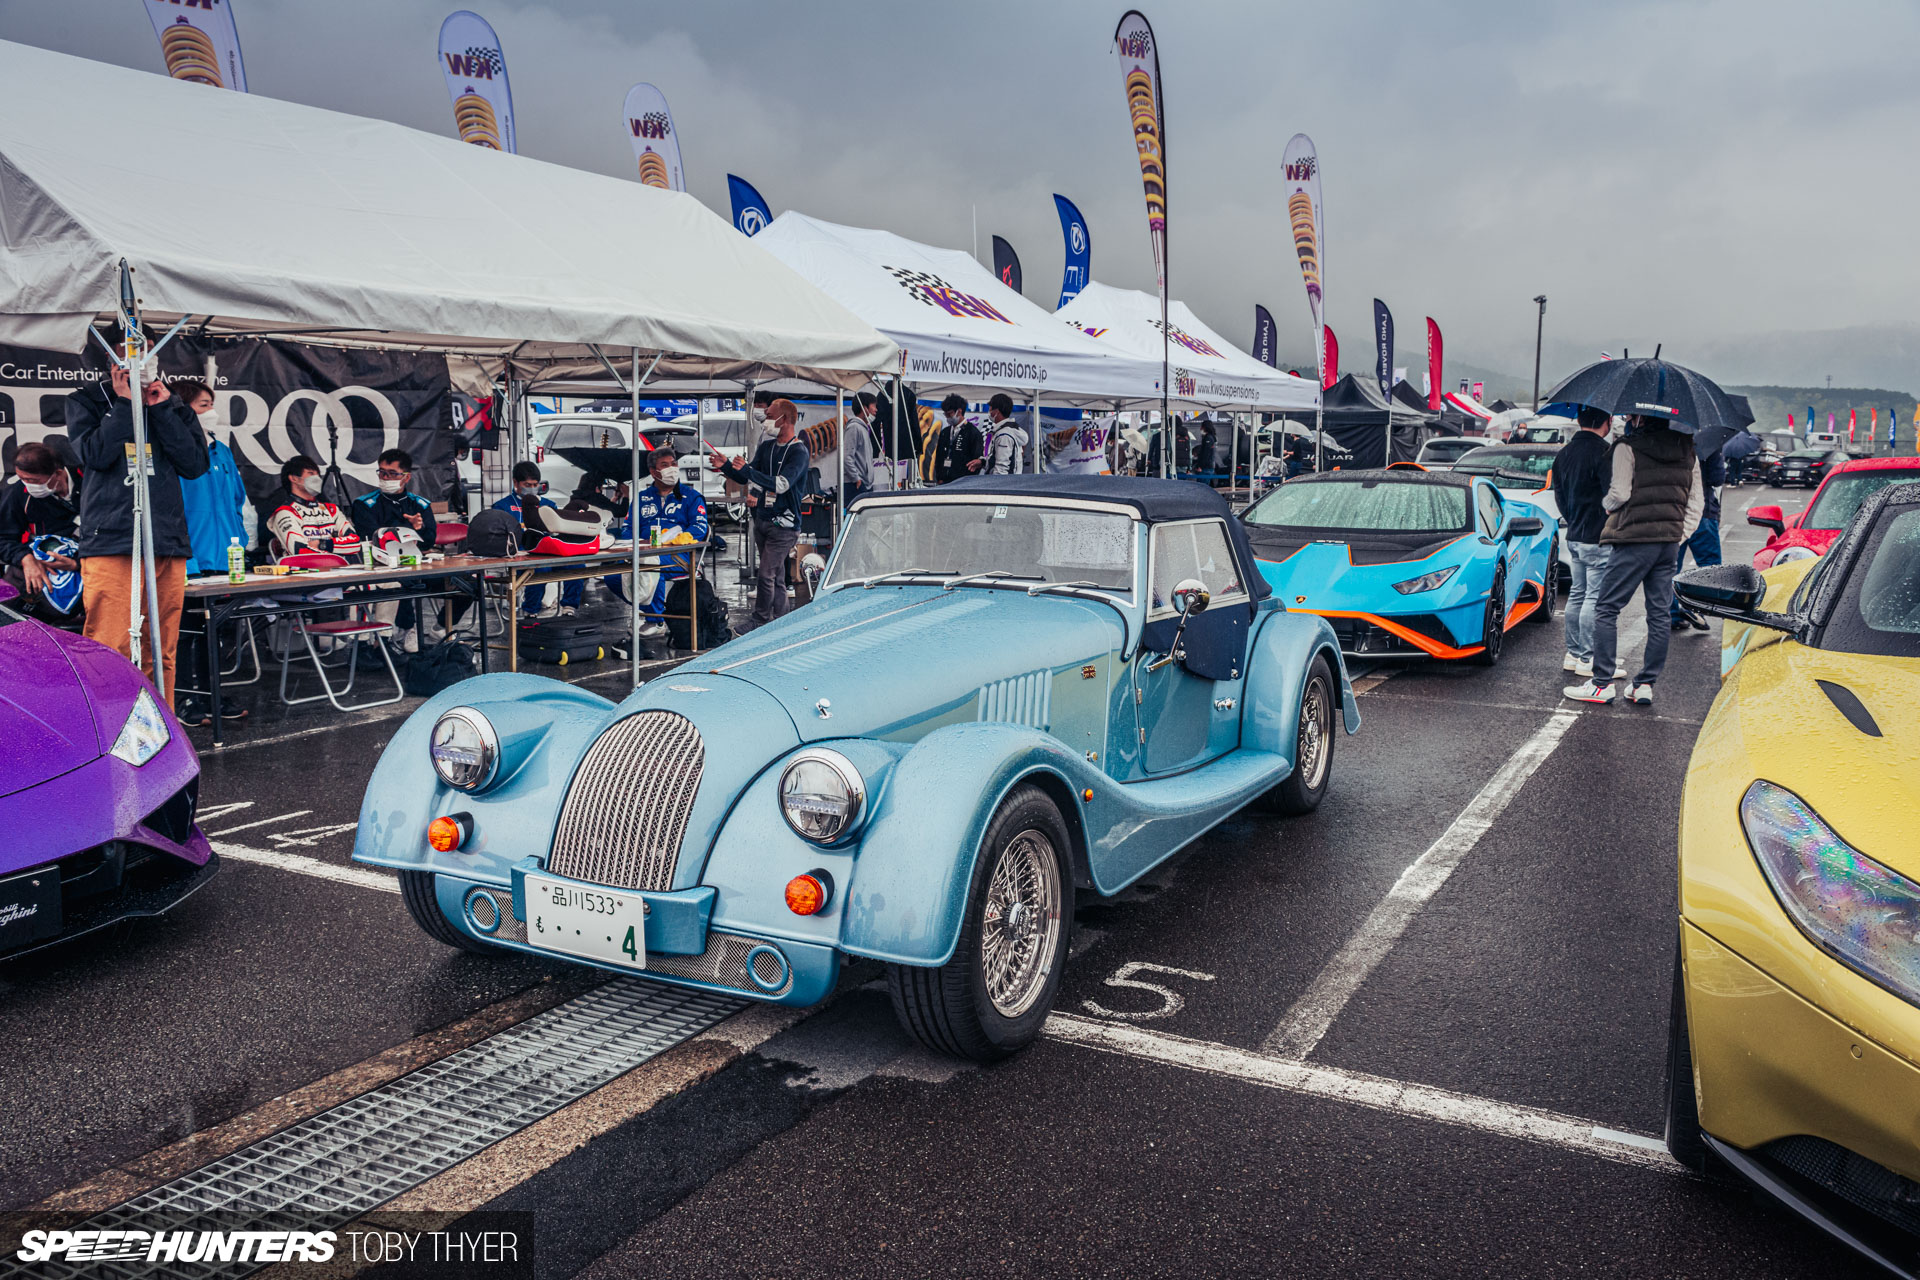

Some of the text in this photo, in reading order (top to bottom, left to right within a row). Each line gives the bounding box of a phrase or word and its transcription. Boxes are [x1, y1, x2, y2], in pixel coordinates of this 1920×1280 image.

[917, 284, 1016, 326] KW
[0, 362, 34, 380] Car
[912, 351, 1048, 384] www.kwsuspensions.jp
